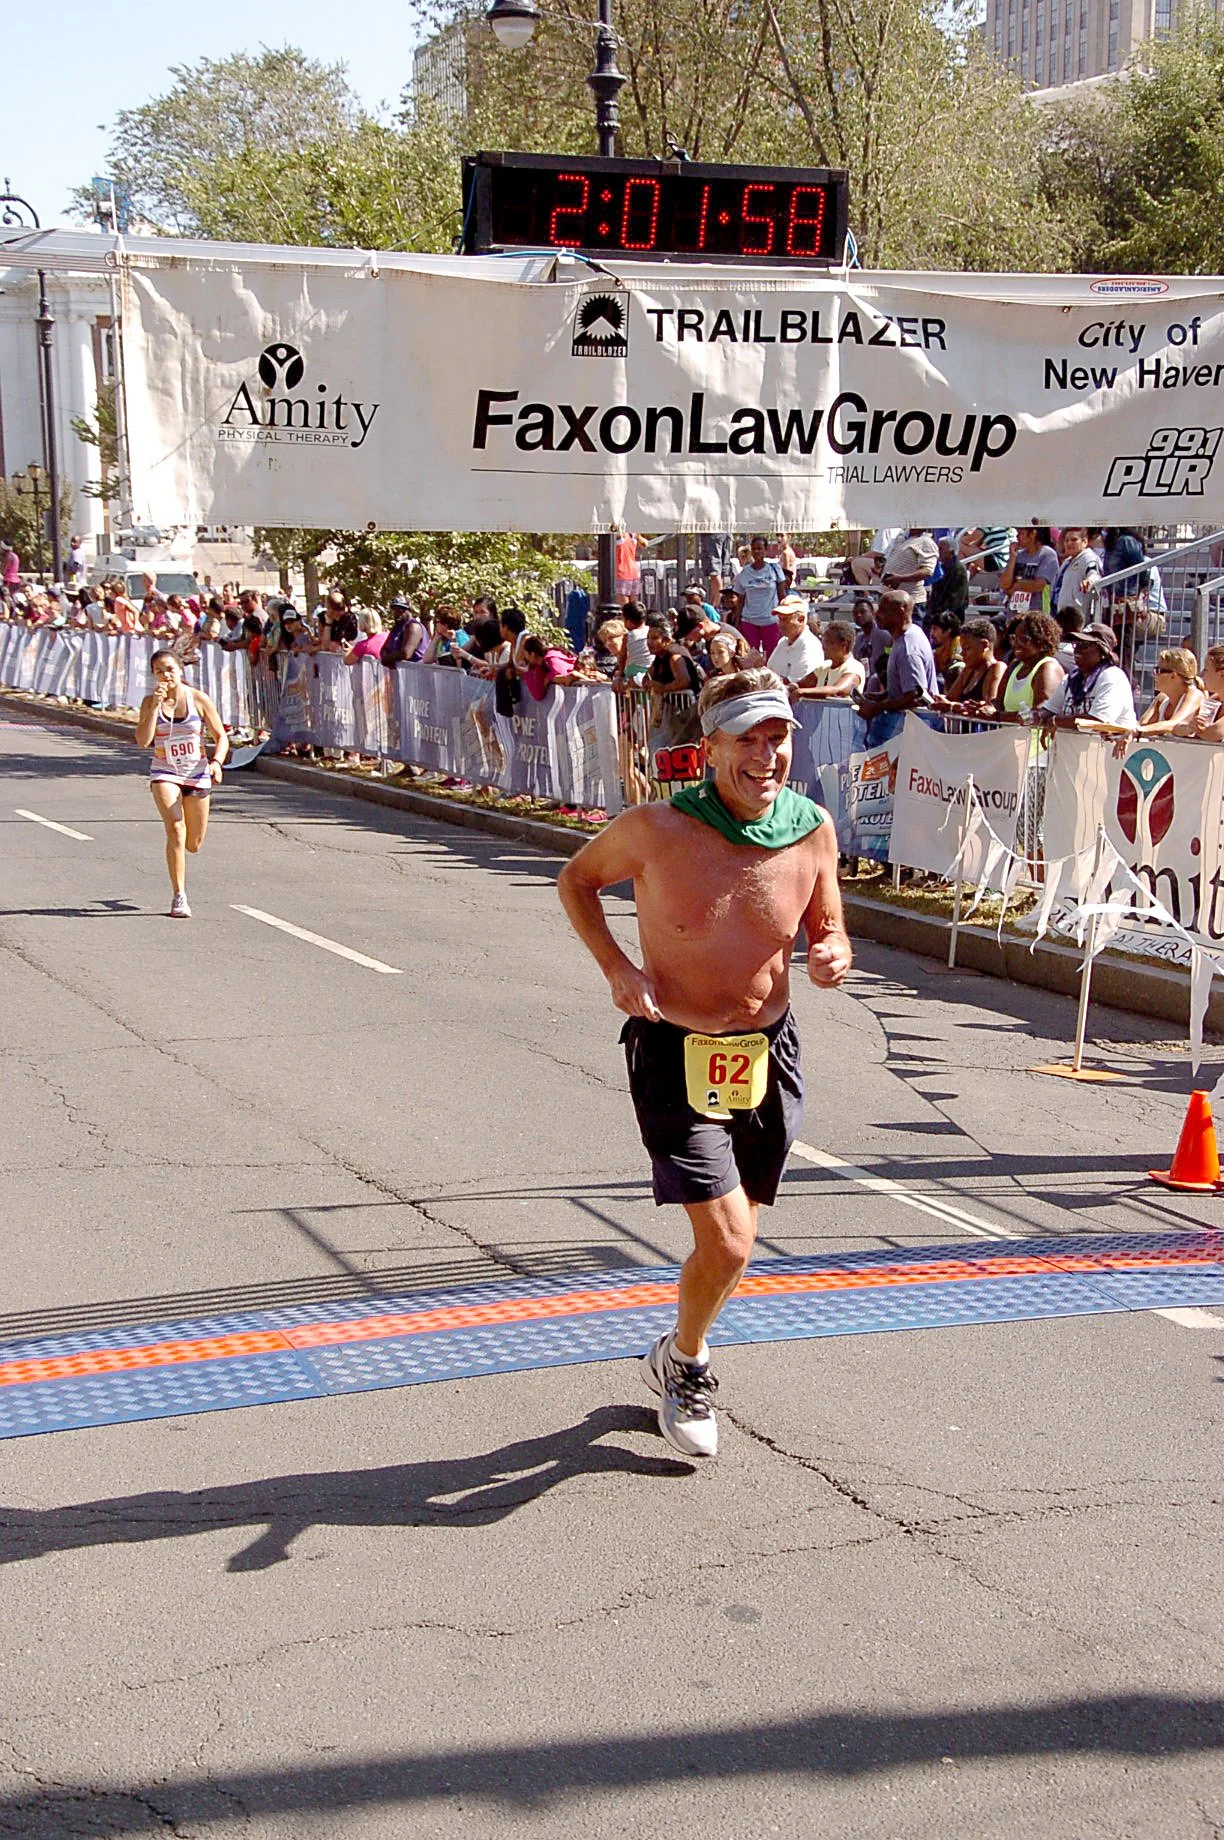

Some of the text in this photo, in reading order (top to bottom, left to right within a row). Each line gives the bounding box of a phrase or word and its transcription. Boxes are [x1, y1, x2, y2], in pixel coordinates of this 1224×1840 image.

[646, 308, 947, 351] TRAILBLAZER
[1078, 316, 1202, 353] City of
[573, 345, 628, 357] TRAILBLAZER
[1044, 358, 1118, 390] New
[221, 381, 381, 449] Amity
[472, 390, 1016, 472] FaxonLawGroup
[217, 428, 350, 445] PHYSICAL THERAPY
[1147, 427, 1223, 458] 99.1
[827, 465, 964, 484] TRIAL LAWYERS
[1102, 456, 1214, 497] PLR
[170, 741, 194, 757] 690
[709, 1052, 750, 1085] 62
